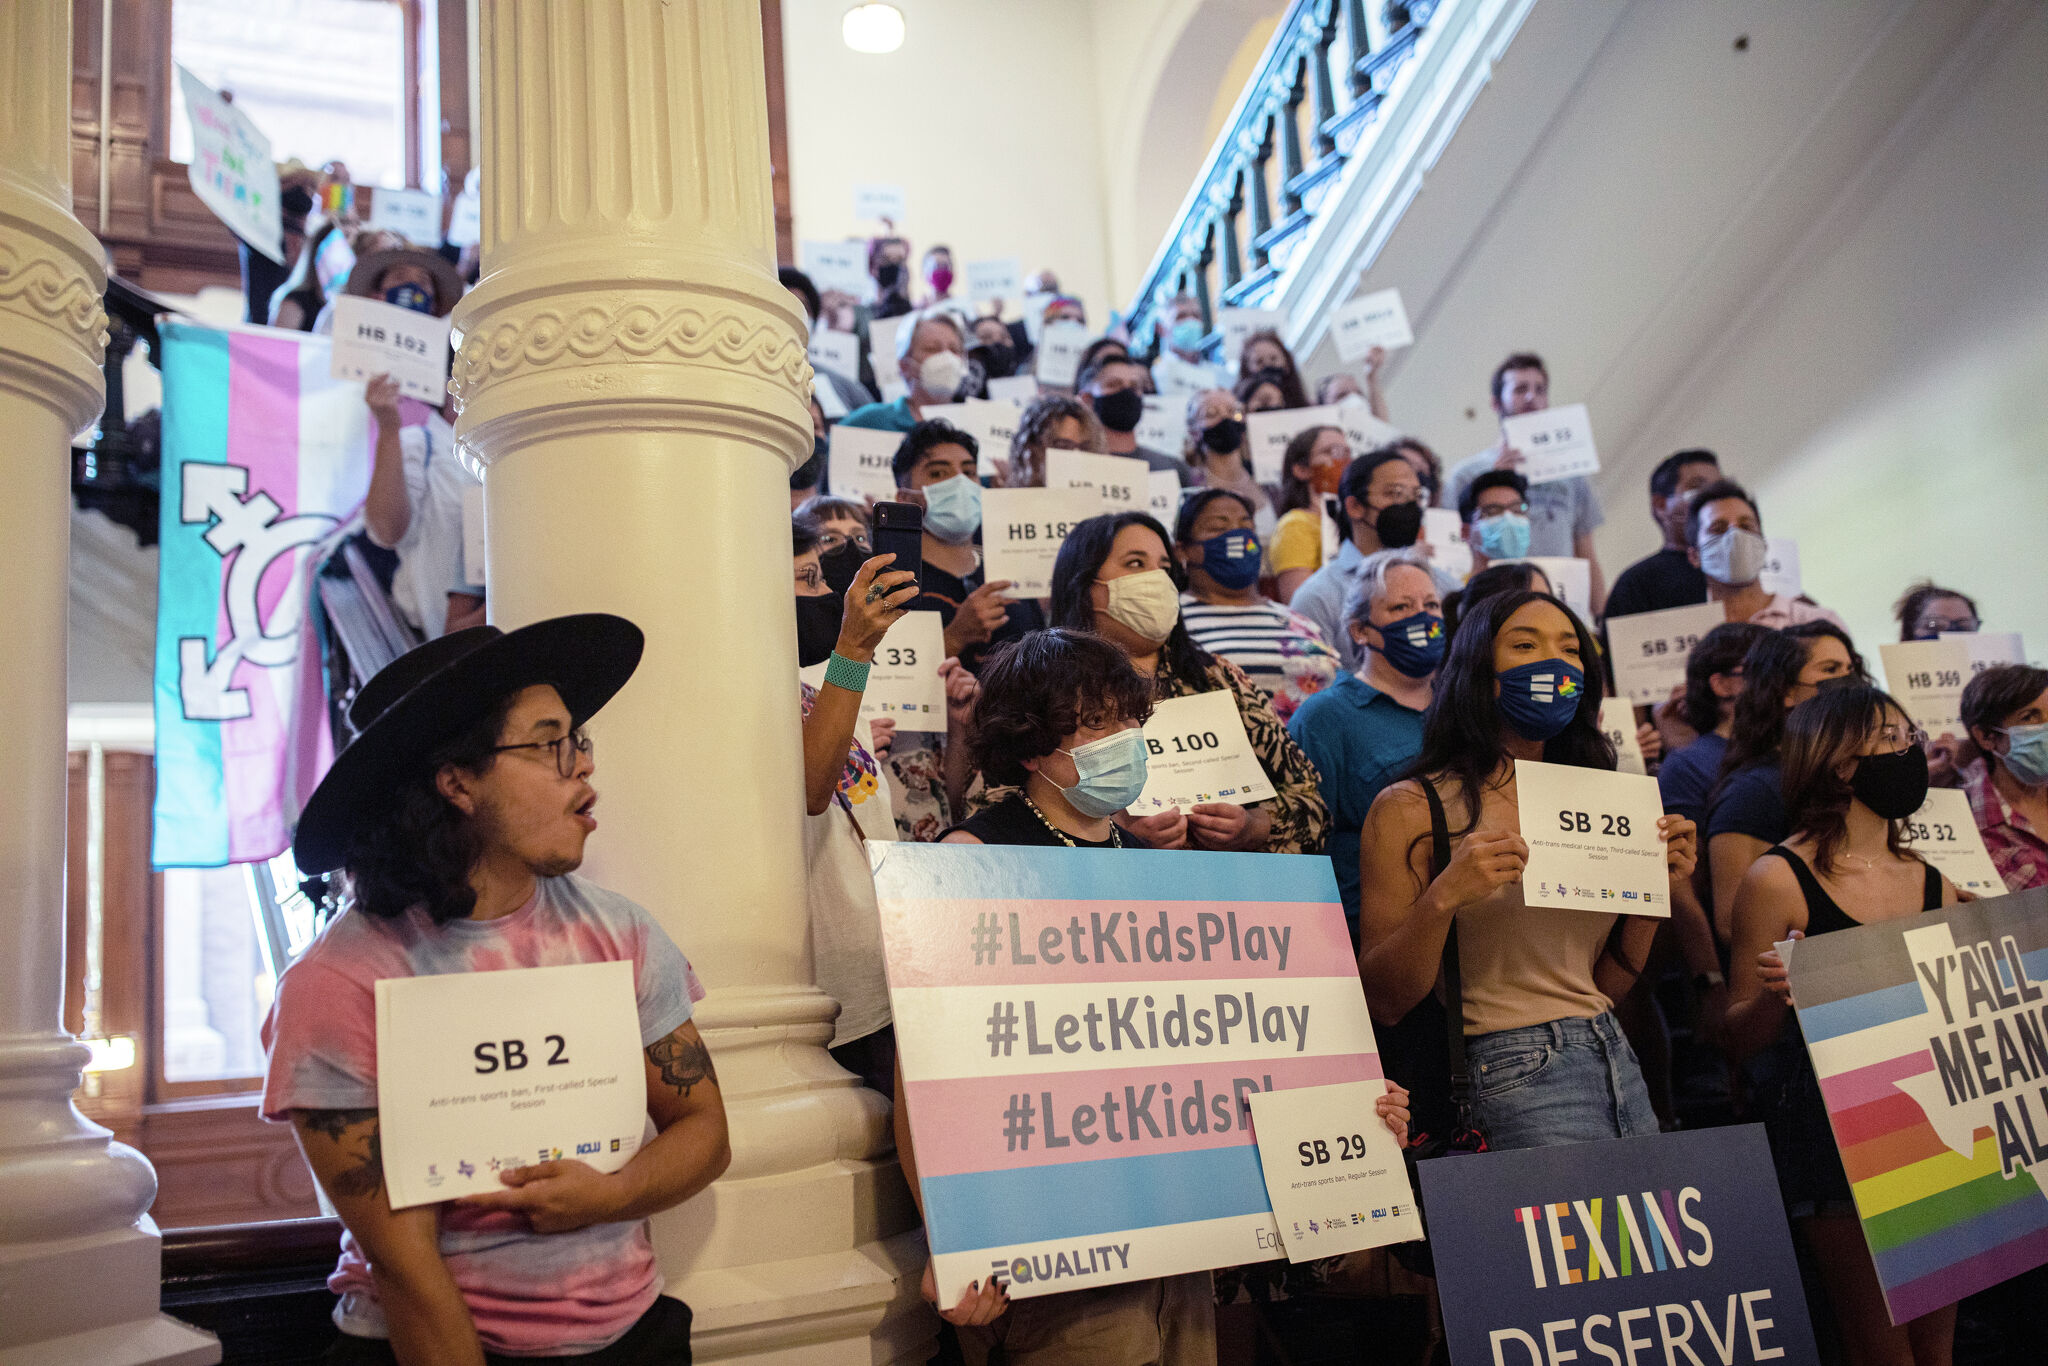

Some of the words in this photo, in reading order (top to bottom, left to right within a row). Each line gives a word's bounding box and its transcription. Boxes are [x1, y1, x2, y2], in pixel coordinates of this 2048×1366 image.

[357, 324, 386, 342] HB
[1101, 484, 1132, 501] 185
[1009, 523, 1037, 540] HB
[887, 648, 917, 666] 33
[1641, 639, 1668, 657] SB
[1908, 672, 1932, 689] HB
[1936, 670, 1960, 687] 369
[1171, 731, 1219, 754] 100
[1558, 810, 1592, 833] SB
[1601, 814, 1632, 837] 28
[1910, 822, 1930, 840] SB
[1933, 823, 1957, 841] 32
[1532, 839, 1560, 848] Anti-trans
[1561, 841, 1583, 850] medical
[1596, 845, 1609, 854] ban,
[1610, 847, 1641, 857] Third-called
[1641, 849, 1660, 859] Special
[1588, 852, 1609, 861] Session
[1622, 890, 1638, 900] ACLU
[970, 909, 1292, 972] #LetKidsPlay
[1917, 939, 2044, 1025] Y'ALL
[985, 991, 1311, 1059] #LetKidsPlay
[473, 1039, 529, 1075] SB
[544, 1034, 570, 1067] 2
[429, 1093, 477, 1108] Anti-trans
[479, 1088, 509, 1103] sports
[510, 1085, 532, 1099] ban,
[534, 1080, 585, 1095] First-called
[587, 1075, 618, 1089] Special
[510, 1098, 546, 1112] Session
[576, 1140, 601, 1156] ACLU
[1298, 1139, 1331, 1167] SB
[1336, 1133, 1367, 1162] 29
[1291, 1178, 1317, 1190] Anti-trans
[1317, 1176, 1335, 1187] sports
[1334, 1174, 1347, 1184] ban,
[1347, 1170, 1368, 1182] Regular
[1368, 1168, 1388, 1178] Session
[1371, 1207, 1387, 1219] ACLU
[1514, 1186, 1714, 1289] TEXANS
[991, 1242, 1131, 1286] EQUALITY
[1488, 1287, 1785, 1366] DESERVE
